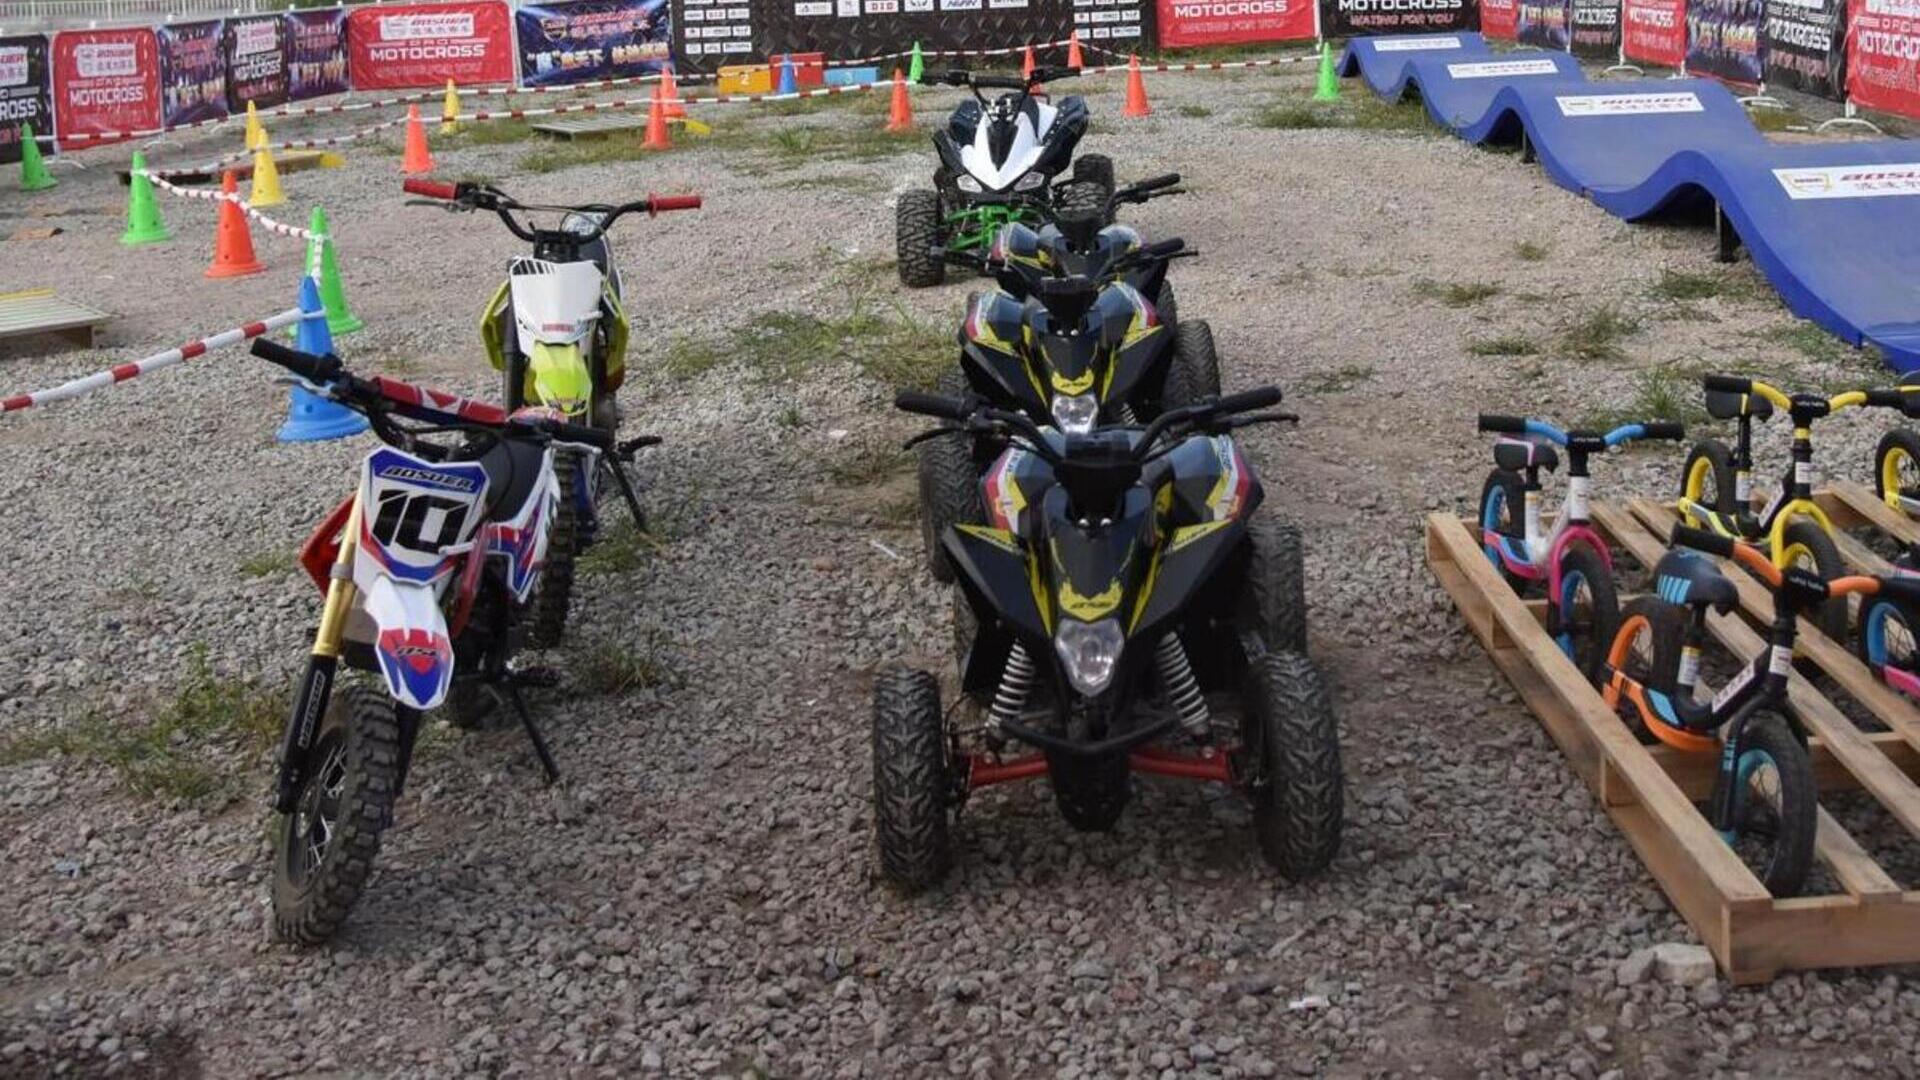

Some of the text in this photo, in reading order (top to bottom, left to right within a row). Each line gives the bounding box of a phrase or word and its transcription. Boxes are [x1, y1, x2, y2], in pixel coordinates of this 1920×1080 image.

[1174, 1, 1288, 18] MOTOCROSS
[1427, 13, 1454, 24] YOU
[370, 44, 485, 62] MOTOCROSS
[70, 84, 144, 107] MOTOCROSS
[381, 465, 474, 492] BOSUER
[372, 488, 470, 556] 10
